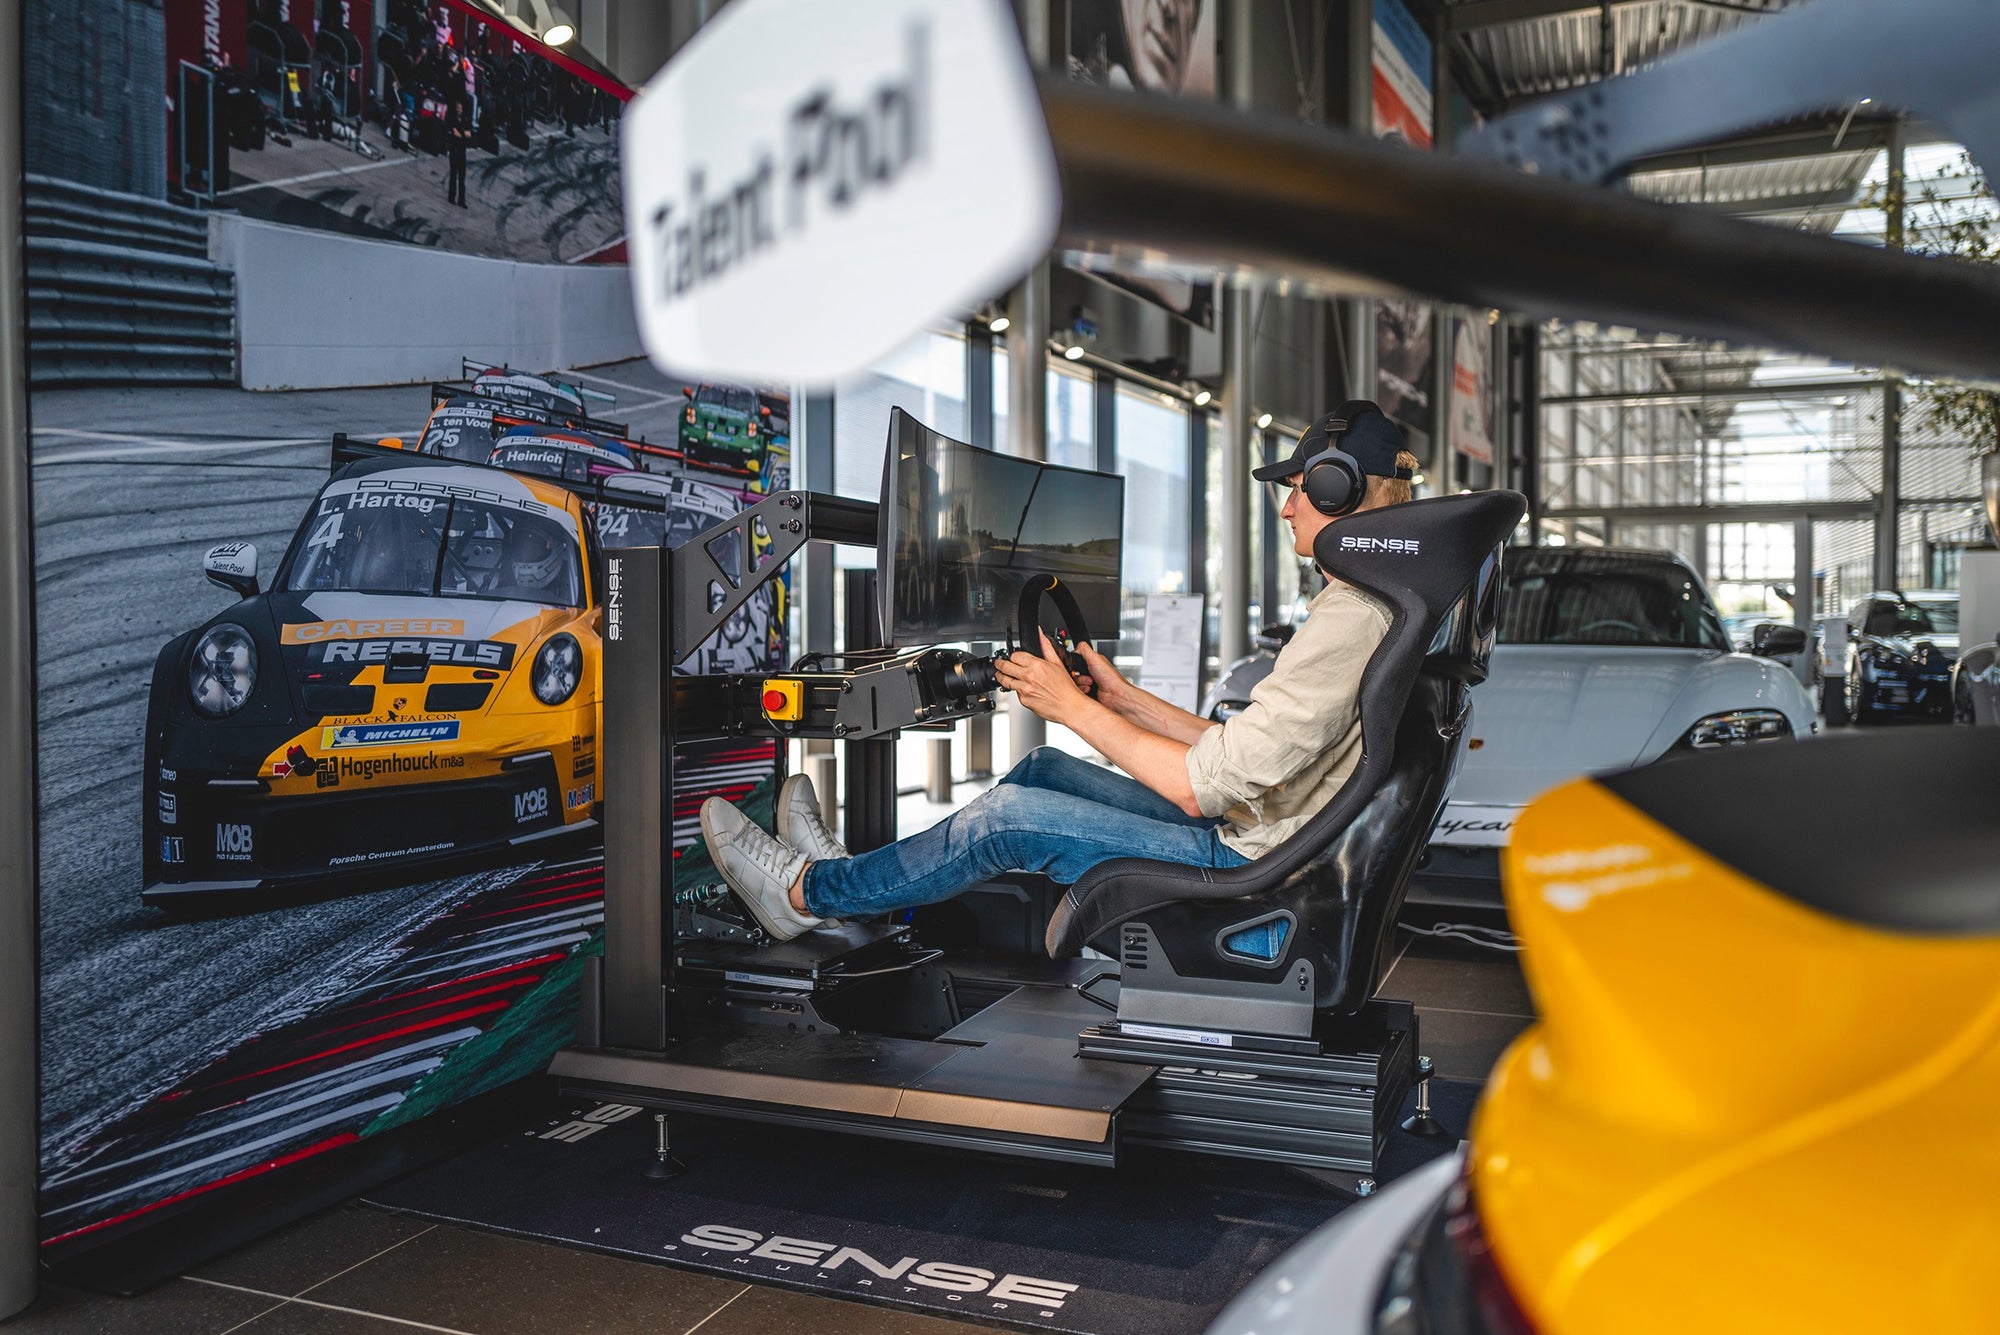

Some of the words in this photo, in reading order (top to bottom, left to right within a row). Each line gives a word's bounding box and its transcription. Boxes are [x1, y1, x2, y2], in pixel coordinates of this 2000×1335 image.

[652, 140, 776, 305] Talent
[785, 10, 932, 235] Pool
[443, 418, 463, 426] ten
[424, 428, 460, 454] 25
[507, 450, 563, 464] Heinrich
[318, 500, 340, 516] L.
[348, 493, 435, 513] Hartog
[357, 480, 548, 516] PORSCHE
[307, 513, 344, 549] 4
[597, 514, 629, 537] 94
[1341, 536, 1420, 551] SENSE
[229, 563, 245, 573] Pool
[609, 558, 619, 640] SENSE
[296, 621, 454, 640] CAREER
[322, 641, 503, 665] REBELS
[333, 715, 383, 725] BLACK
[400, 713, 457, 722] FALCON
[364, 727, 449, 740] MICHELIN
[341, 751, 438, 780] Hogenhouck
[440, 755, 464, 768] m&a
[514, 787, 548, 818] MOB
[216, 823, 253, 852] MOB
[329, 854, 366, 866] Porsche
[368, 849, 406, 860] Centrum
[406, 842, 454, 854] Amsterdam
[681, 1224, 1080, 1309] SENSE
[664, 1243, 1055, 1318] SIMULATORS
